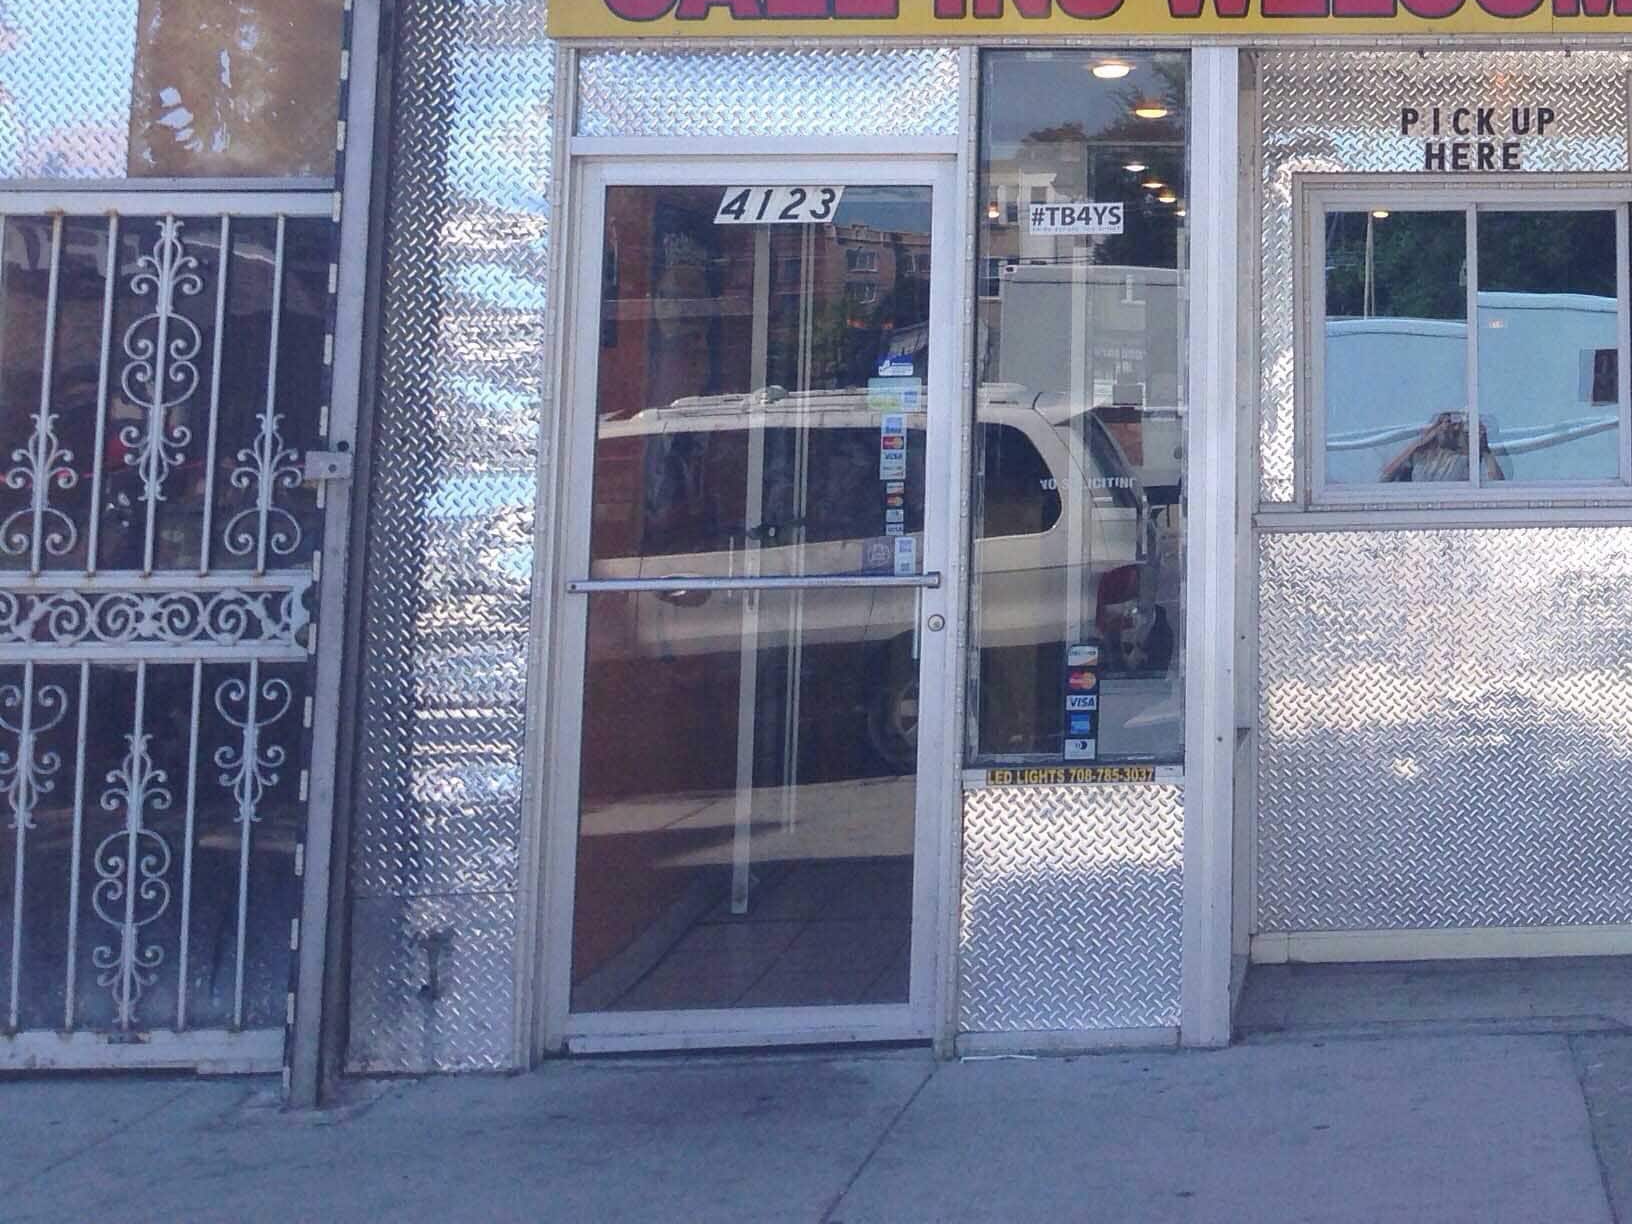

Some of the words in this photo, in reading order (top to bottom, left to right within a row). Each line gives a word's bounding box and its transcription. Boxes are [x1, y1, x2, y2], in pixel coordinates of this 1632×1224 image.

[1401, 107, 1496, 136] PICK
[1511, 107, 1555, 136] UP
[1424, 142, 1521, 170] HERE
[719, 187, 837, 220] 4123
[1031, 205, 1122, 227] #TB4YS
[1070, 696, 1096, 708] VISA
[986, 769, 1012, 785] LED
[1016, 768, 1065, 785] LIGHTS
